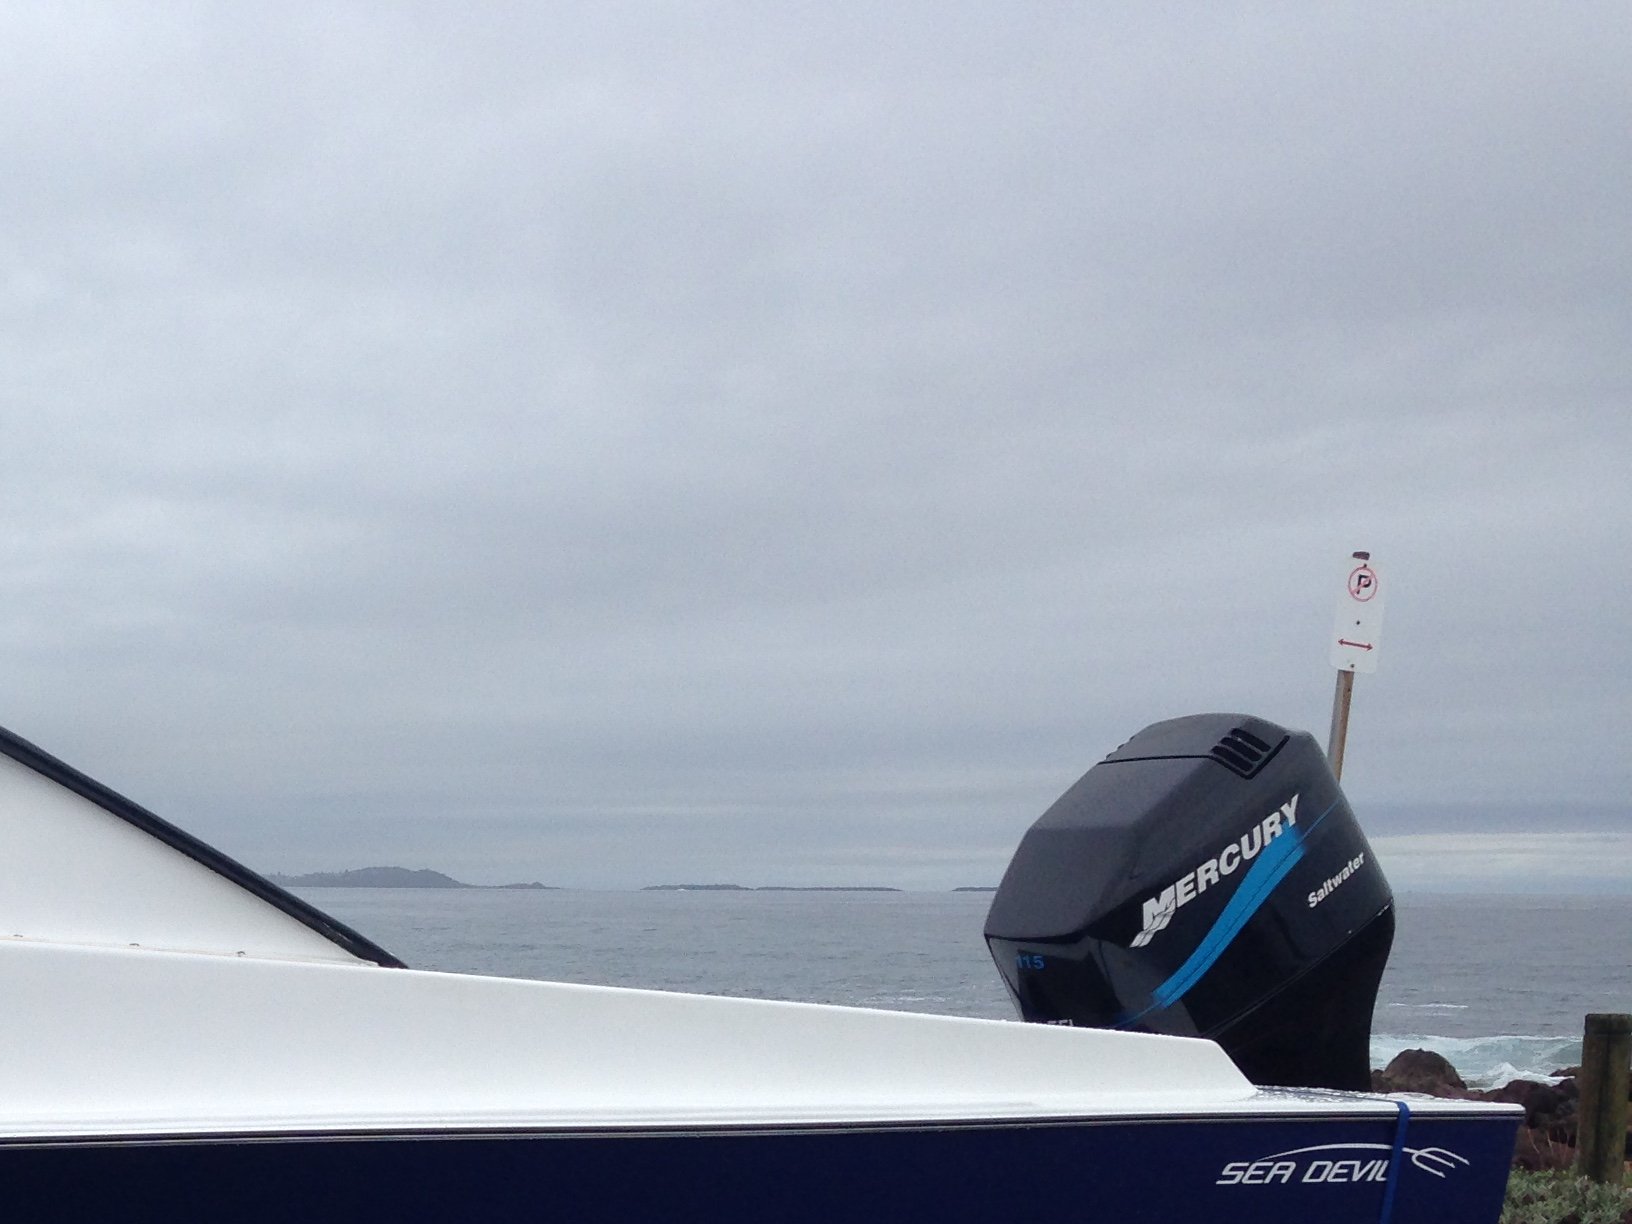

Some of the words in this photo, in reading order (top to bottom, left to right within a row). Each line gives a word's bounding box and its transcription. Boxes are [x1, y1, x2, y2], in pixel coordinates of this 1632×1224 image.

[1129, 793, 1300, 949] MERCURY
[1307, 852, 1365, 909] Saltwater
[1016, 954, 1045, 970] 115
[1216, 1160, 1297, 1185] SEA
[1301, 1159, 1389, 1183] DEVIL
